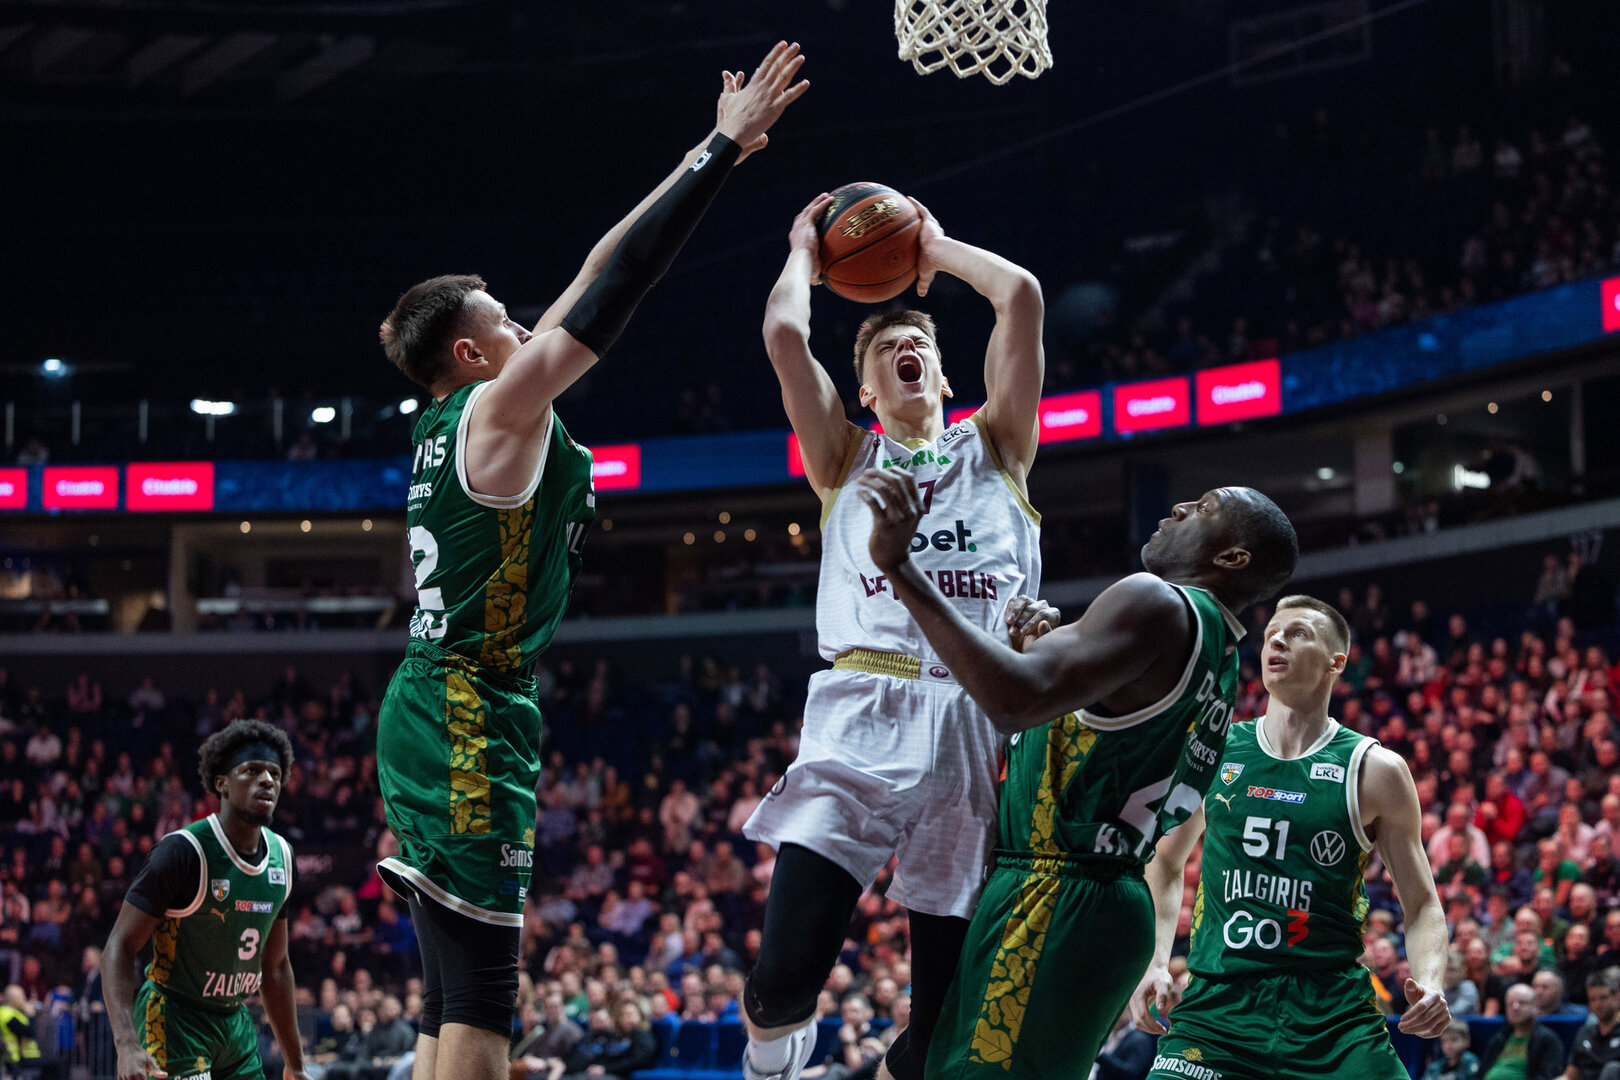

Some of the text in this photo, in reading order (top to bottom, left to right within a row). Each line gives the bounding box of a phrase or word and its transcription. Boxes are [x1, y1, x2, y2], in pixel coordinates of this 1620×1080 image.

[1316, 770, 1339, 780] LKL
[1247, 786, 1306, 804] TOPsport
[1242, 816, 1290, 860] 51
[238, 927, 260, 960] 3
